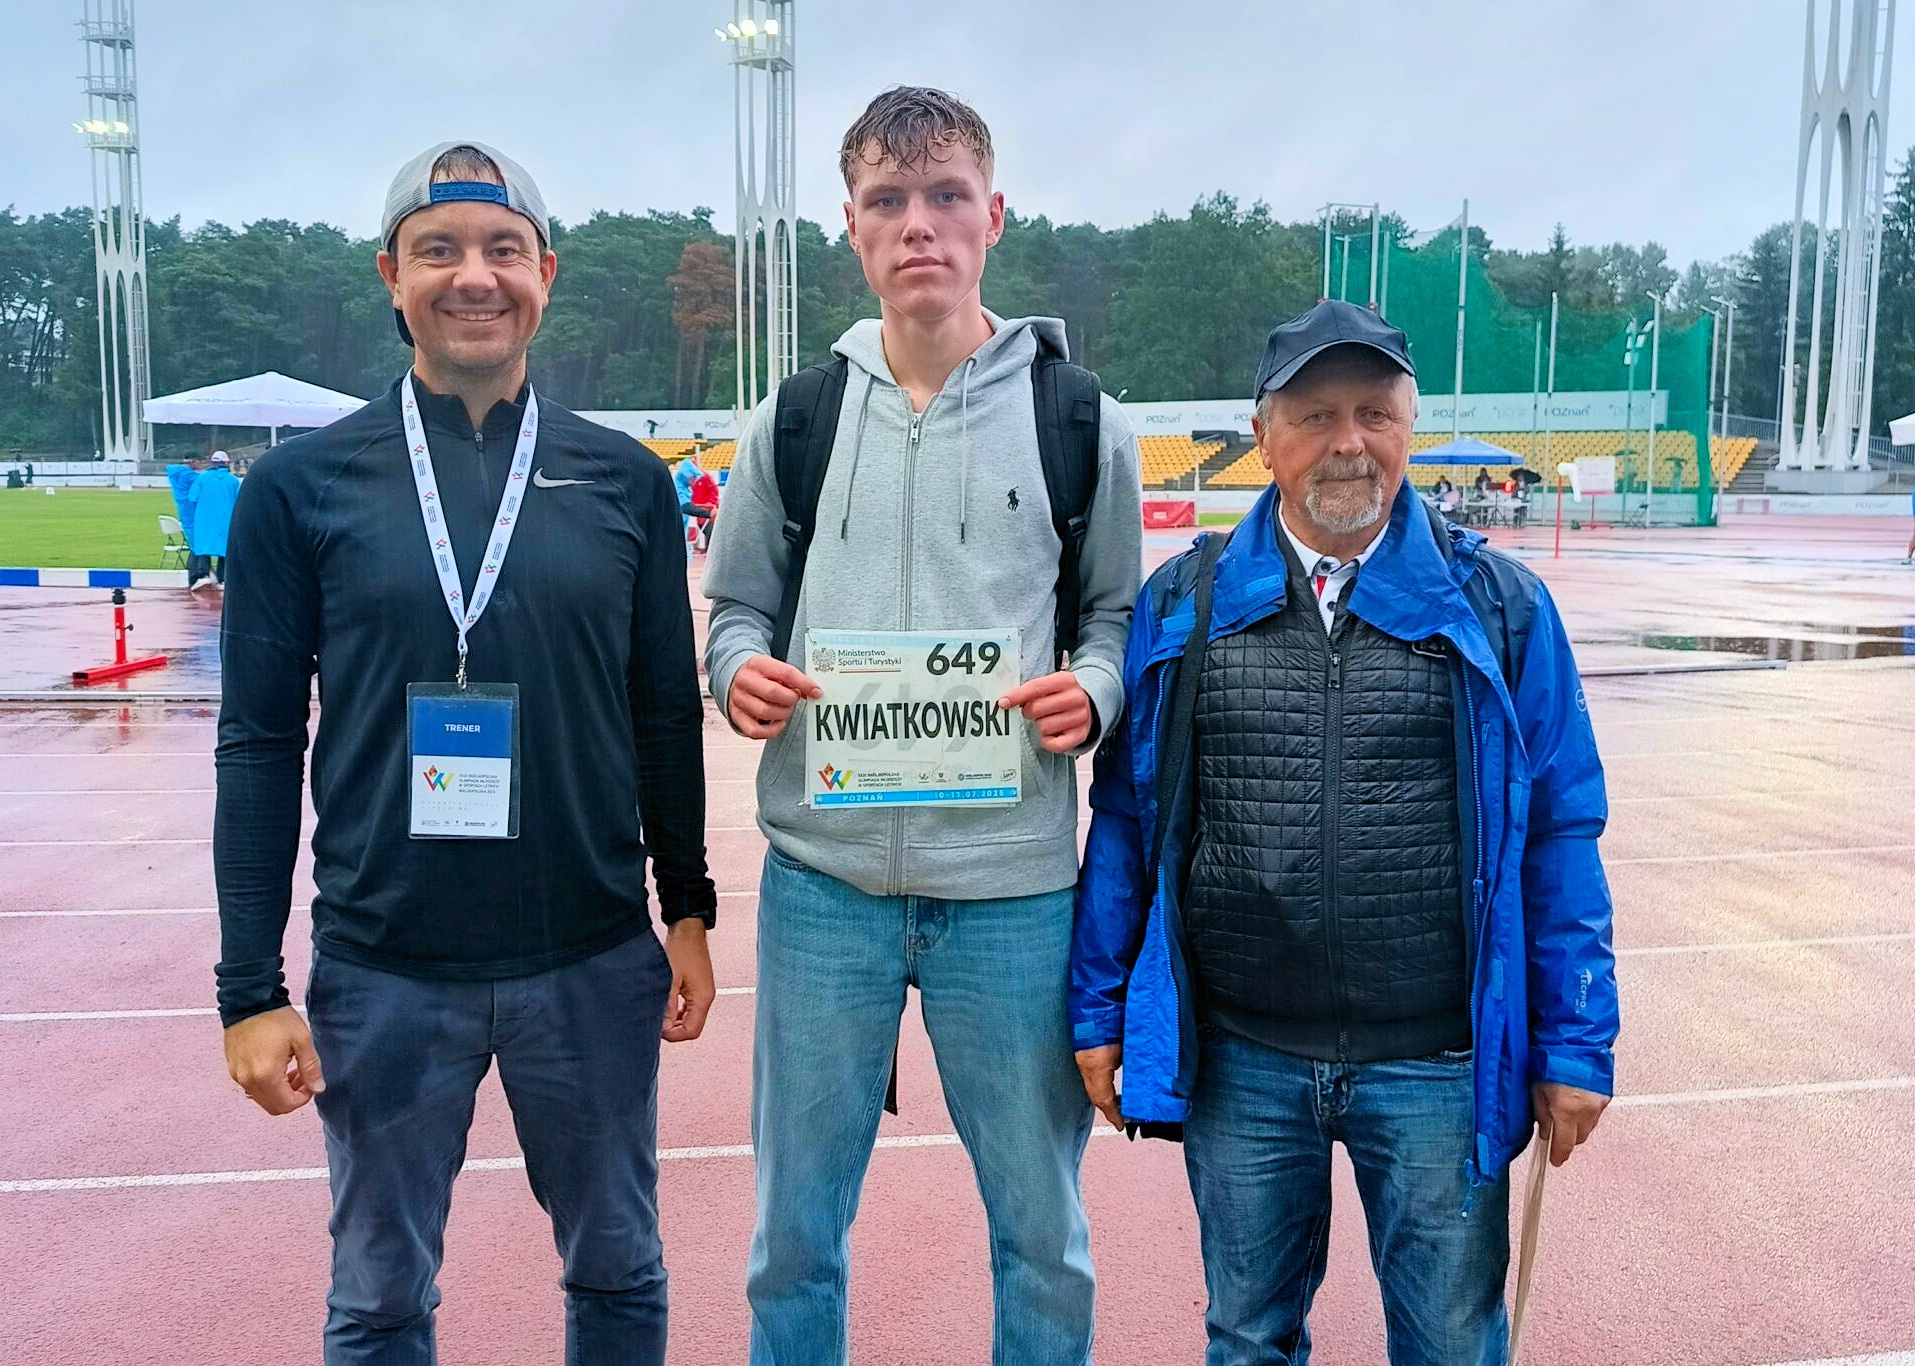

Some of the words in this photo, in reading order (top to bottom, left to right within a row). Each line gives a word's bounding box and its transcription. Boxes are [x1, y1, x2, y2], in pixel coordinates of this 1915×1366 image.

[838, 648, 886, 657] Ministerstwo
[838, 658, 862, 667] Sportu
[868, 657, 902, 667] Turystyki
[926, 641, 1001, 675] 649
[815, 700, 1010, 741] KWIATKOWSKI
[444, 723, 481, 733] TRENER
[842, 792, 884, 802] POZNAŃ
